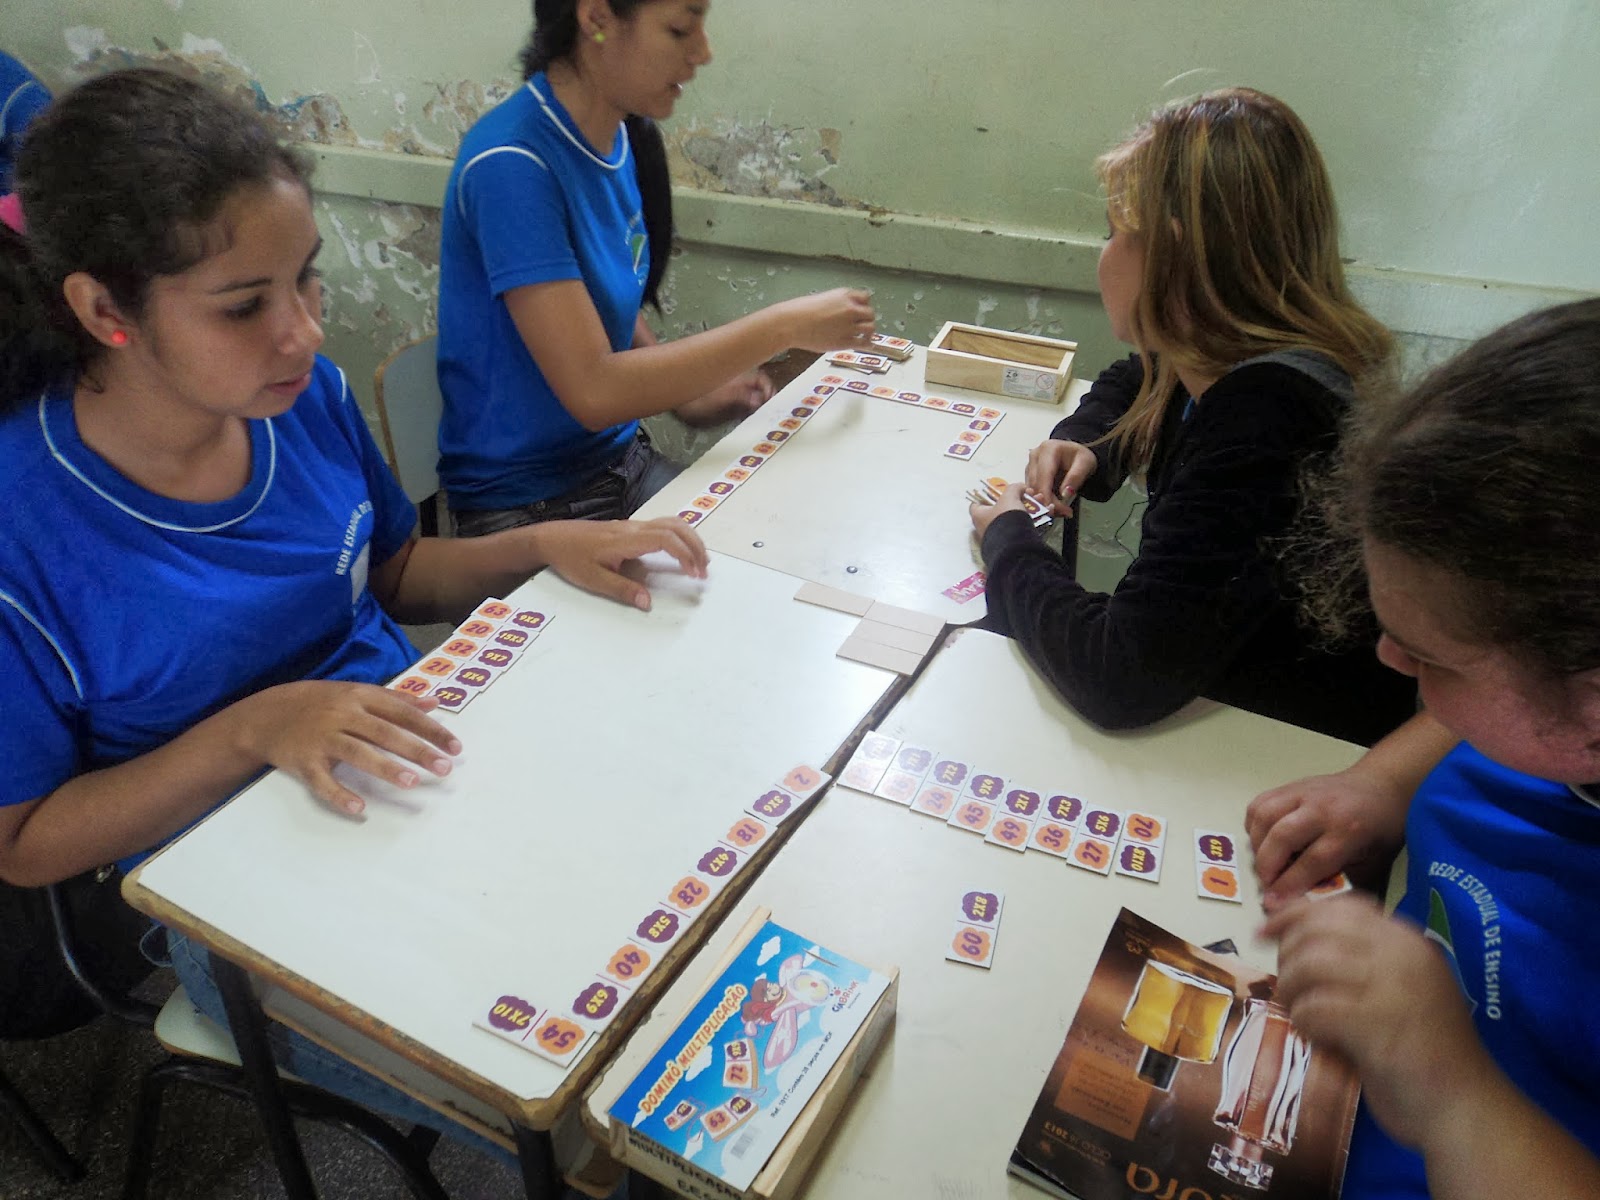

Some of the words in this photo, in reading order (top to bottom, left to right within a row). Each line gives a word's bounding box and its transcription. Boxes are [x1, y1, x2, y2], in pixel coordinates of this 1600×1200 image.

[698, 497, 713, 508] 21
[335, 548, 352, 575] REDE
[484, 605, 509, 618] 63
[518, 614, 541, 625] 9X8
[465, 623, 490, 635] 20
[448, 641, 475, 654] 32
[484, 651, 508, 663] 9X7
[426, 661, 451, 673] 21
[401, 679, 427, 693] 30
[437, 690, 463, 702] 7X7
[794, 773, 810, 785] 2
[942, 764, 959, 782] 7X2
[978, 778, 995, 796] 9X4
[763, 795, 784, 813] 3X6
[927, 791, 947, 810] 24
[1015, 793, 1031, 811] 2X1
[1056, 799, 1073, 818] 7X3
[964, 804, 984, 825] 45
[1094, 814, 1111, 833] 5X6
[736, 823, 758, 842] 18
[1000, 820, 1021, 841] 49
[1133, 817, 1155, 838] 70
[1044, 827, 1065, 848] 36
[1082, 841, 1103, 864] 27
[1209, 838, 1223, 858] 3X9
[710, 852, 729, 873] 4X7
[1131, 847, 1146, 872] 8X10
[1209, 876, 1230, 886] 1
[1428, 861, 1465, 883] REDE
[677, 881, 702, 905] 28
[1457, 874, 1500, 926] ESTADUAL
[972, 895, 988, 918] 2X8
[648, 915, 671, 938] 5X8
[961, 931, 982, 956] 60
[1484, 925, 1502, 949] DE
[615, 951, 641, 976] 40
[1484, 950, 1502, 1021] ENSINO
[585, 988, 608, 1014] 6X9
[493, 1003, 532, 1026] 7X10
[541, 1024, 576, 1049] 54
[640, 1062, 681, 1114] DOMINÓ
[677, 985, 746, 1068] MULTIPLICAÇÃO
[730, 1065, 743, 1081] 72
[709, 1111, 726, 1128] 63
[1043, 1120, 1069, 1138] 2013
